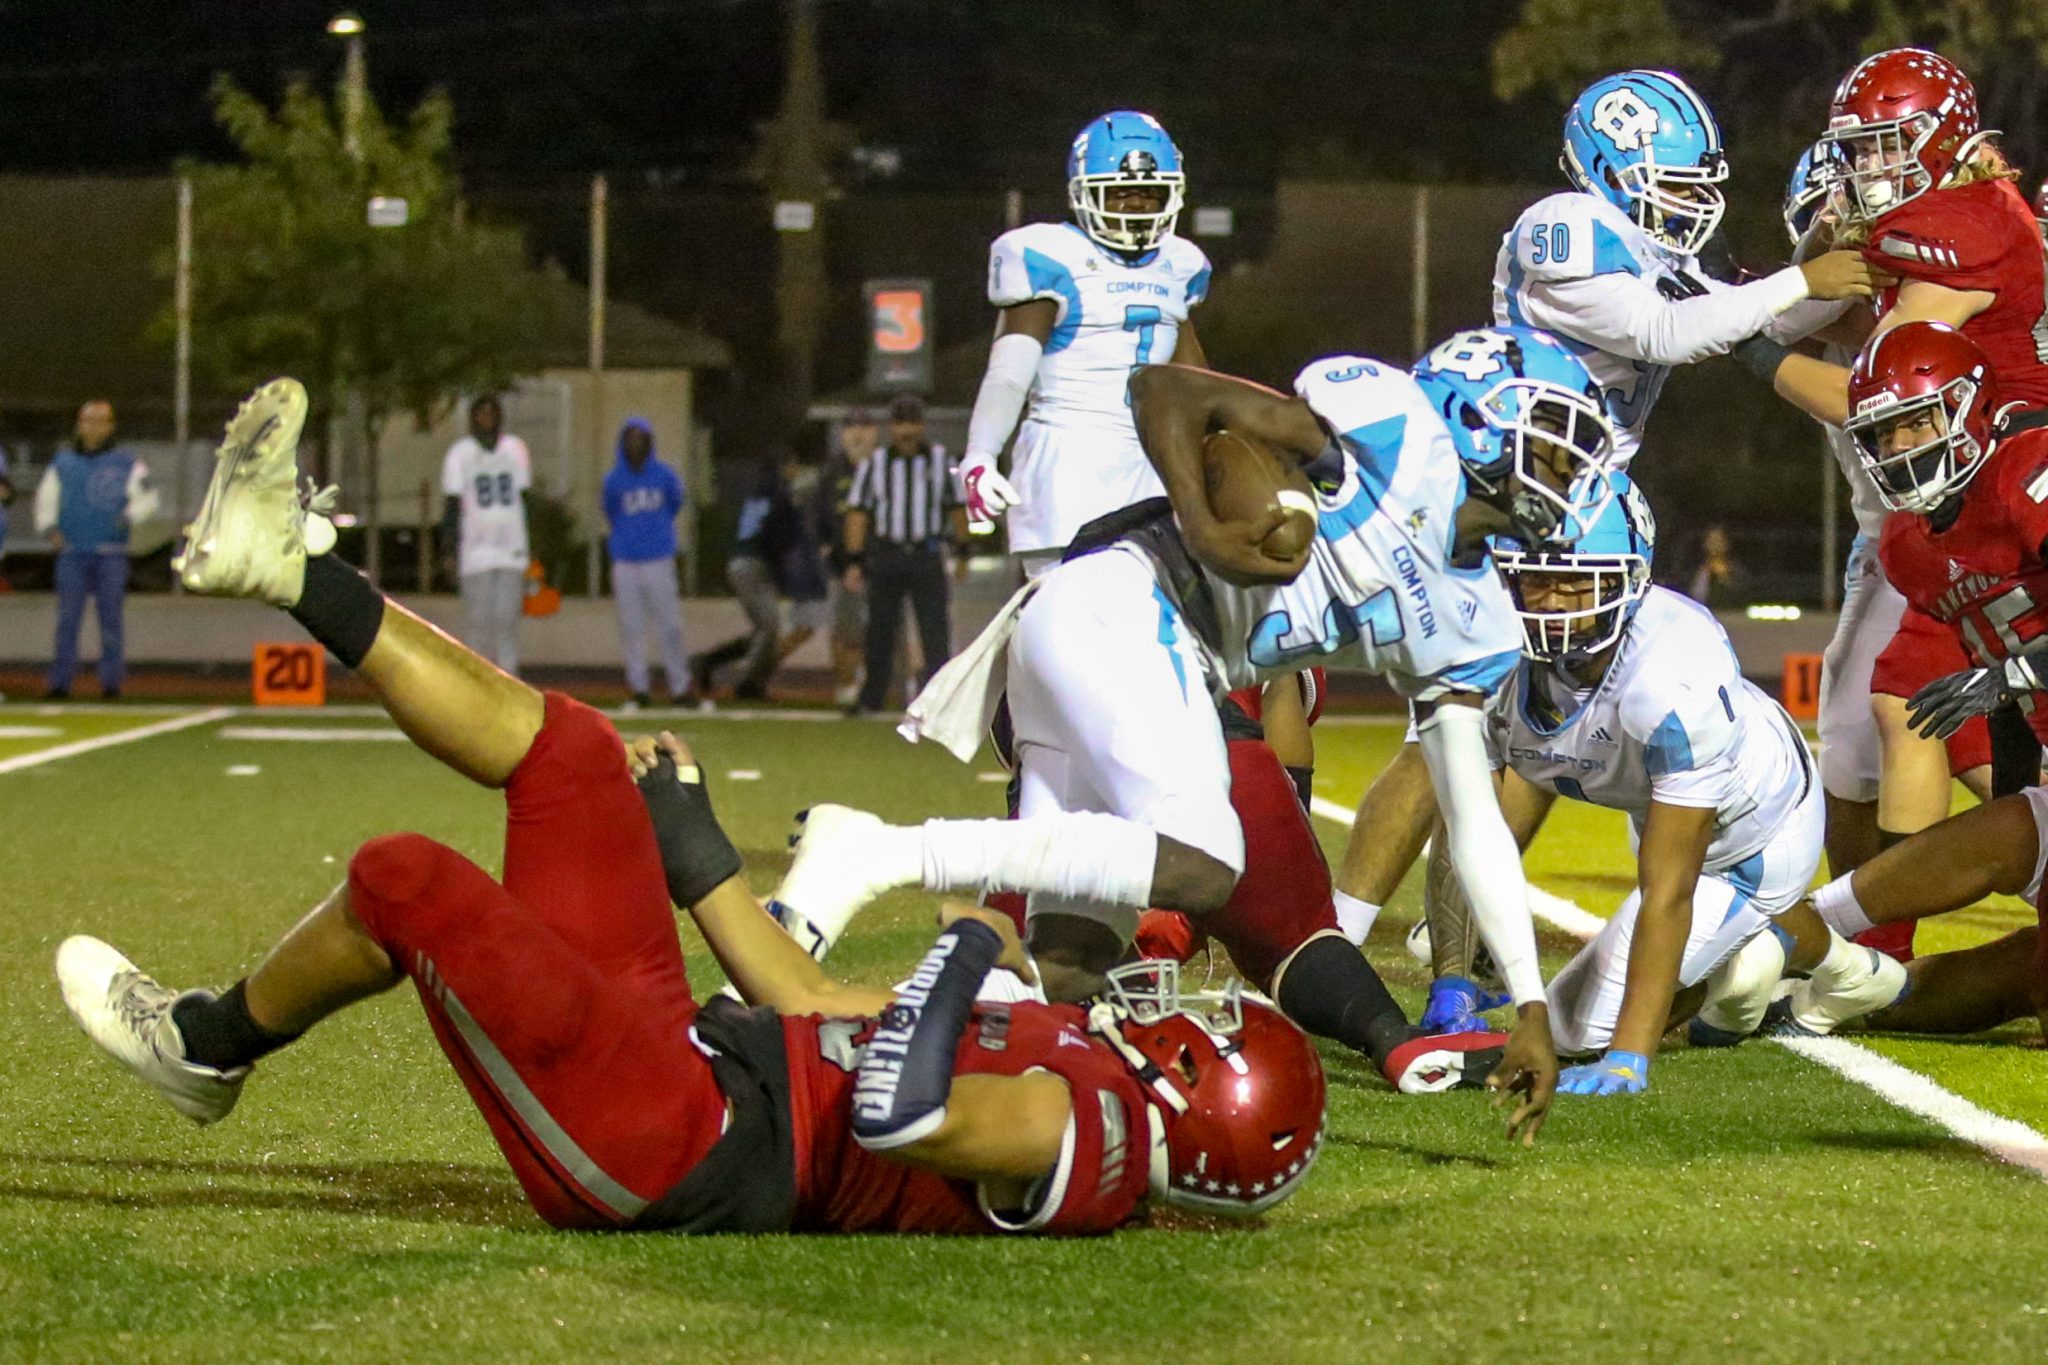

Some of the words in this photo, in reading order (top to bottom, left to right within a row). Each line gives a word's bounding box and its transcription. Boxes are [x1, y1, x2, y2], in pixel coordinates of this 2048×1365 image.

[1532, 223, 1569, 264] 50
[1107, 281, 1169, 297] COMPTON
[1122, 304, 1161, 407] 7
[1325, 363, 1379, 383] 5
[1859, 394, 1889, 412] Riddell
[1391, 544, 1439, 640] COMPTON
[265, 647, 314, 692] 20
[1508, 746, 1607, 772] COMPTON
